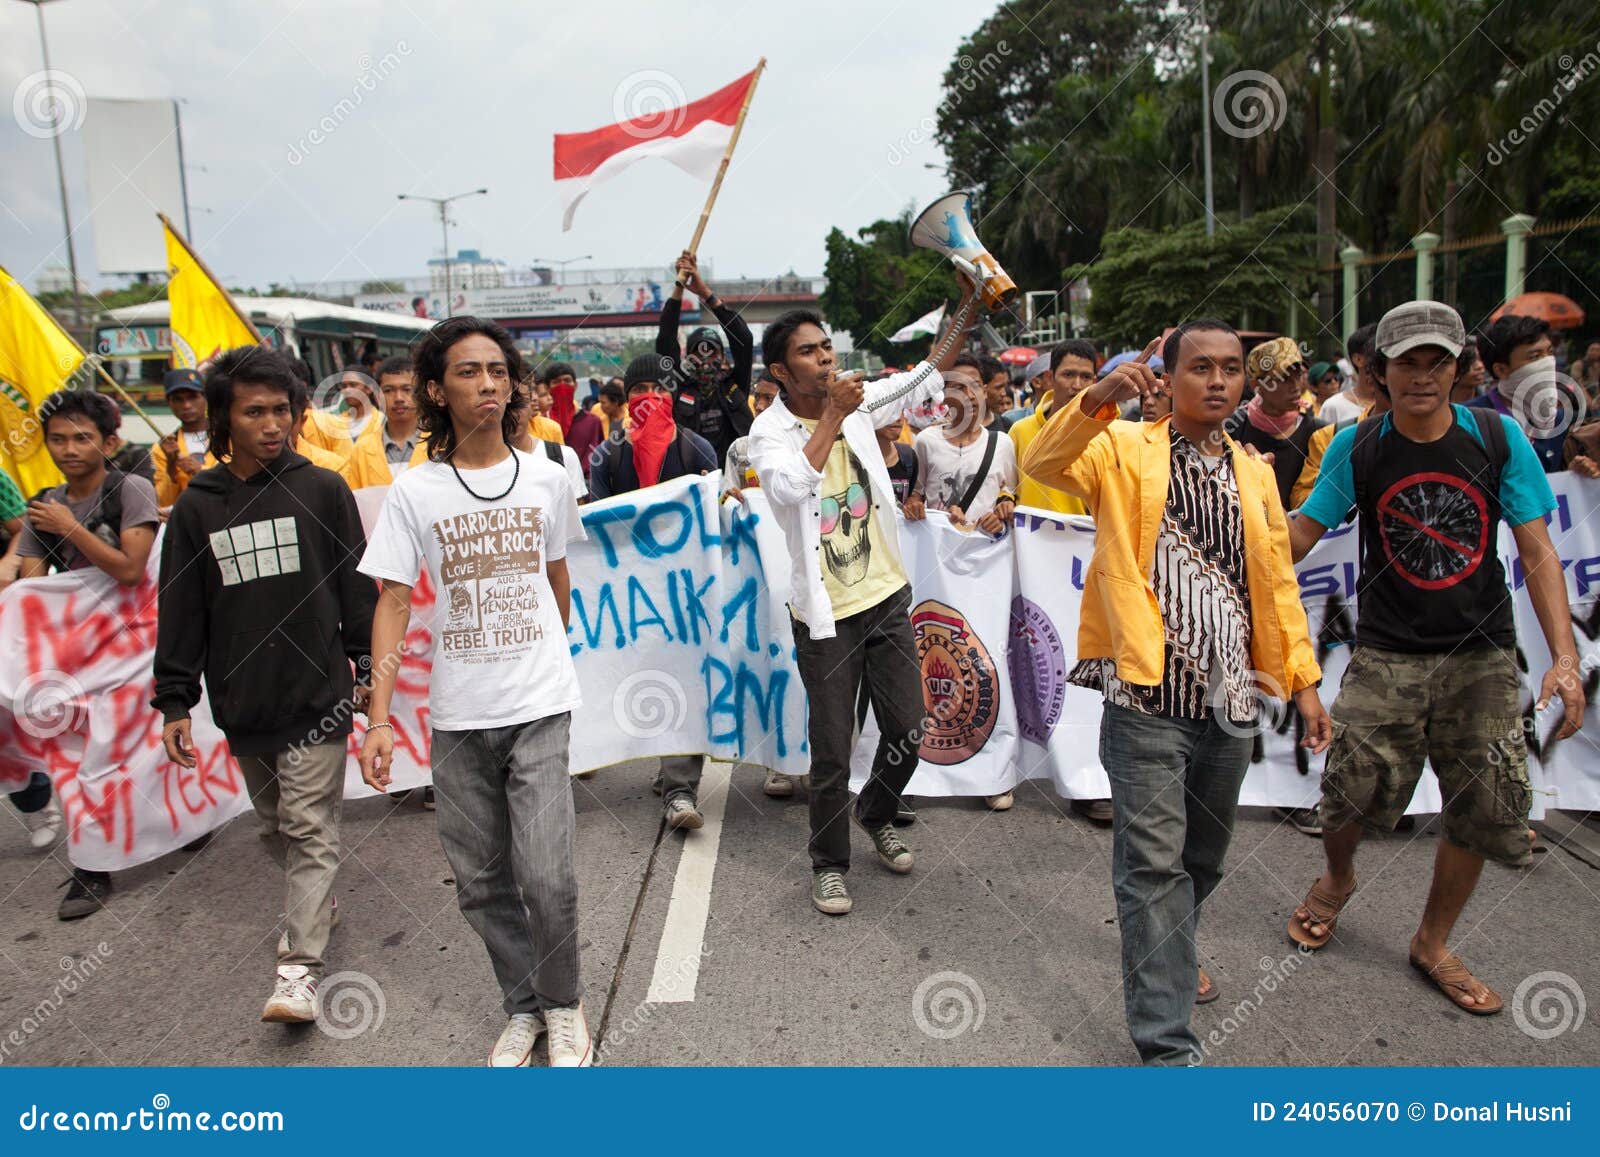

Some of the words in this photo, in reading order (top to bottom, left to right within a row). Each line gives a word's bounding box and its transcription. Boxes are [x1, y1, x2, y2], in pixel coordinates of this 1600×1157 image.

[438, 508, 533, 542] HARDCORE
[444, 535, 498, 562] PUNK
[501, 531, 544, 552] ROCK
[446, 561, 475, 579] LOVE
[496, 575, 515, 585] AUG
[484, 584, 537, 601] SUICIDAL
[480, 596, 540, 615] TENDENCIES
[486, 617, 535, 631] CALIFORNIA
[498, 612, 522, 622] FROM
[443, 632, 488, 651] REBEL
[492, 623, 543, 647] TRUTH
[929, 736, 962, 747] 1958
